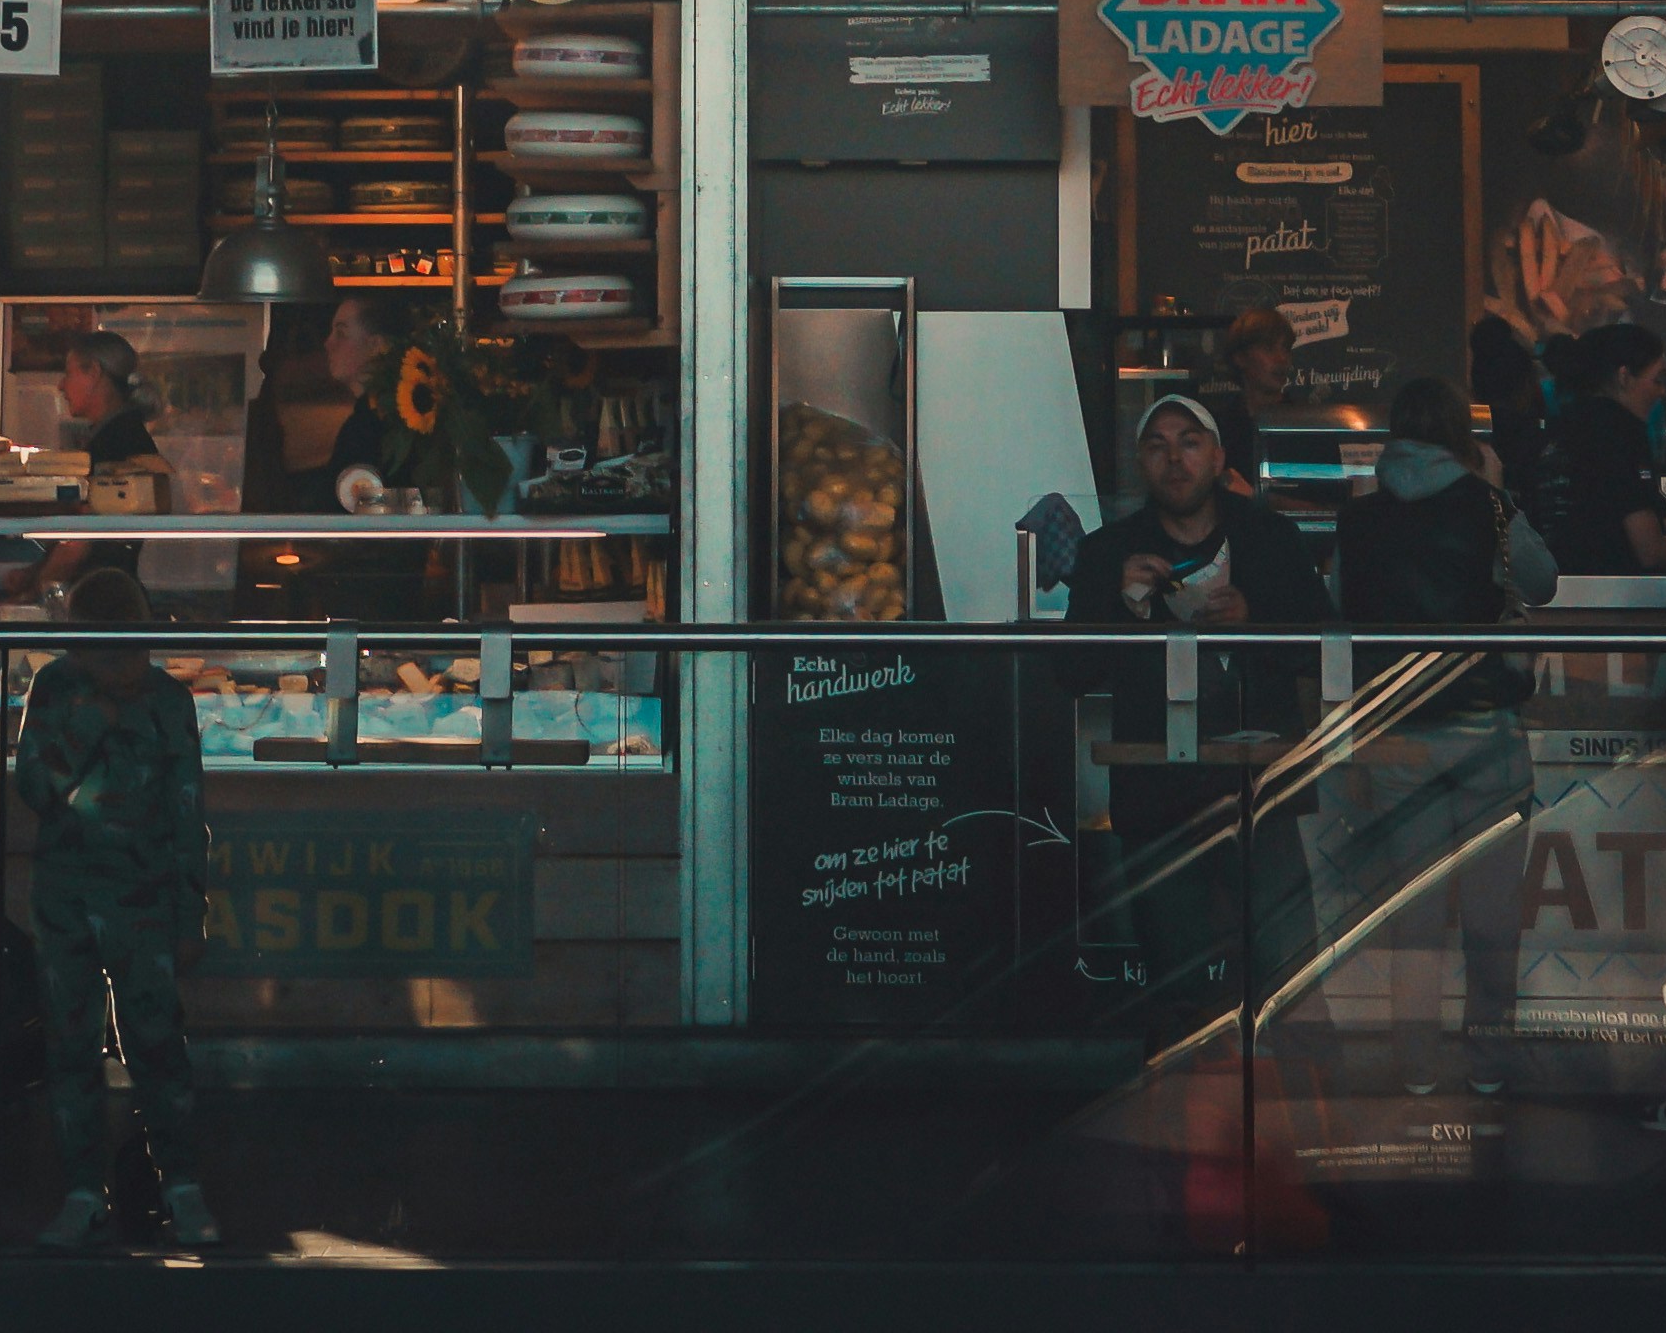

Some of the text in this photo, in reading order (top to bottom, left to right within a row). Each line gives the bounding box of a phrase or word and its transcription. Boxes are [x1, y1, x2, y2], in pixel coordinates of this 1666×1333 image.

[233, 17, 355, 40] vind je hier!
[1136, 19, 1306, 56] LADAGE
[1135, 63, 1312, 108] Echt lekker!
[1265, 116, 1318, 147] hier
[1245, 219, 1318, 271] patat
[1295, 368, 1305, 386] &
[792, 656, 837, 674] Echt
[786, 654, 917, 705] handwerk
[818, 729, 957, 748] Elke dag komen
[1569, 738, 1637, 757] SINDS
[822, 750, 951, 766] ze vers naar de
[837, 771, 937, 787] winkels van
[829, 792, 945, 811] Bram Ladage.
[813, 830, 950, 873] om ze hier te
[801, 855, 973, 909] snijden tot patat
[833, 926, 940, 943] Gewoon met
[825, 948, 947, 966] de hand, zoals
[845, 969, 928, 986] het hoort.
